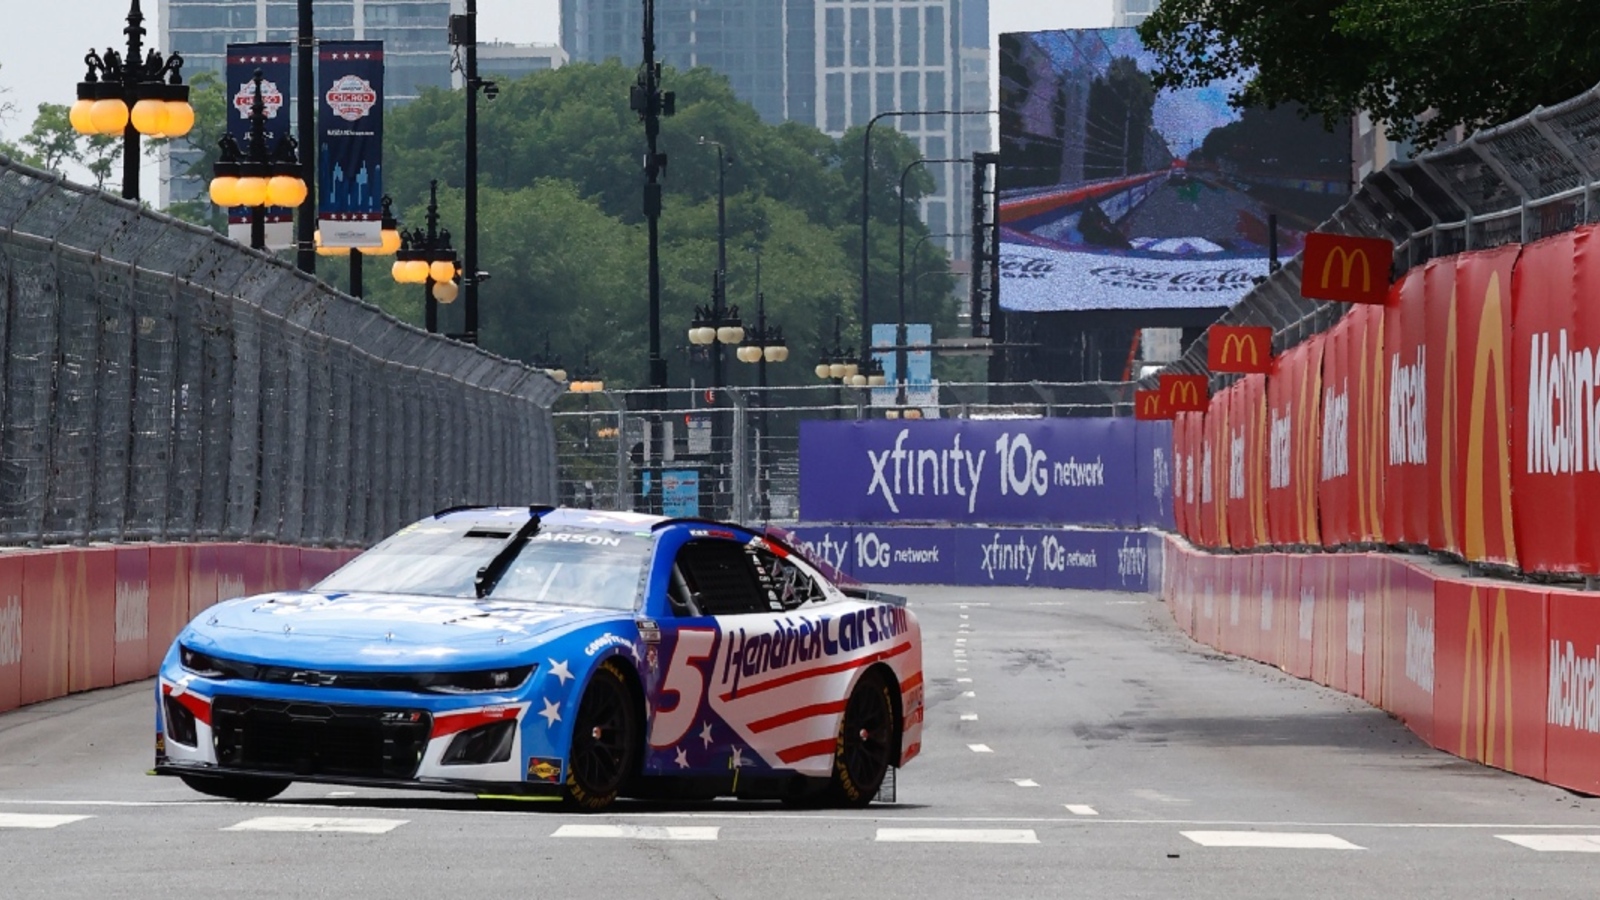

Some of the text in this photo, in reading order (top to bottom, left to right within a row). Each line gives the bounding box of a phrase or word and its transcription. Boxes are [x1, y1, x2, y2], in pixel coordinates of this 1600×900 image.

[867, 428, 986, 513] xfinity
[995, 432, 1048, 496] 10G
[1053, 455, 1104, 487] network
[855, 532, 890, 568] 10G
[893, 545, 939, 563] network
[981, 532, 1098, 581] xfinity 10G network
[645, 628, 715, 748] 5
[721, 605, 909, 699] HendrickCars.com
